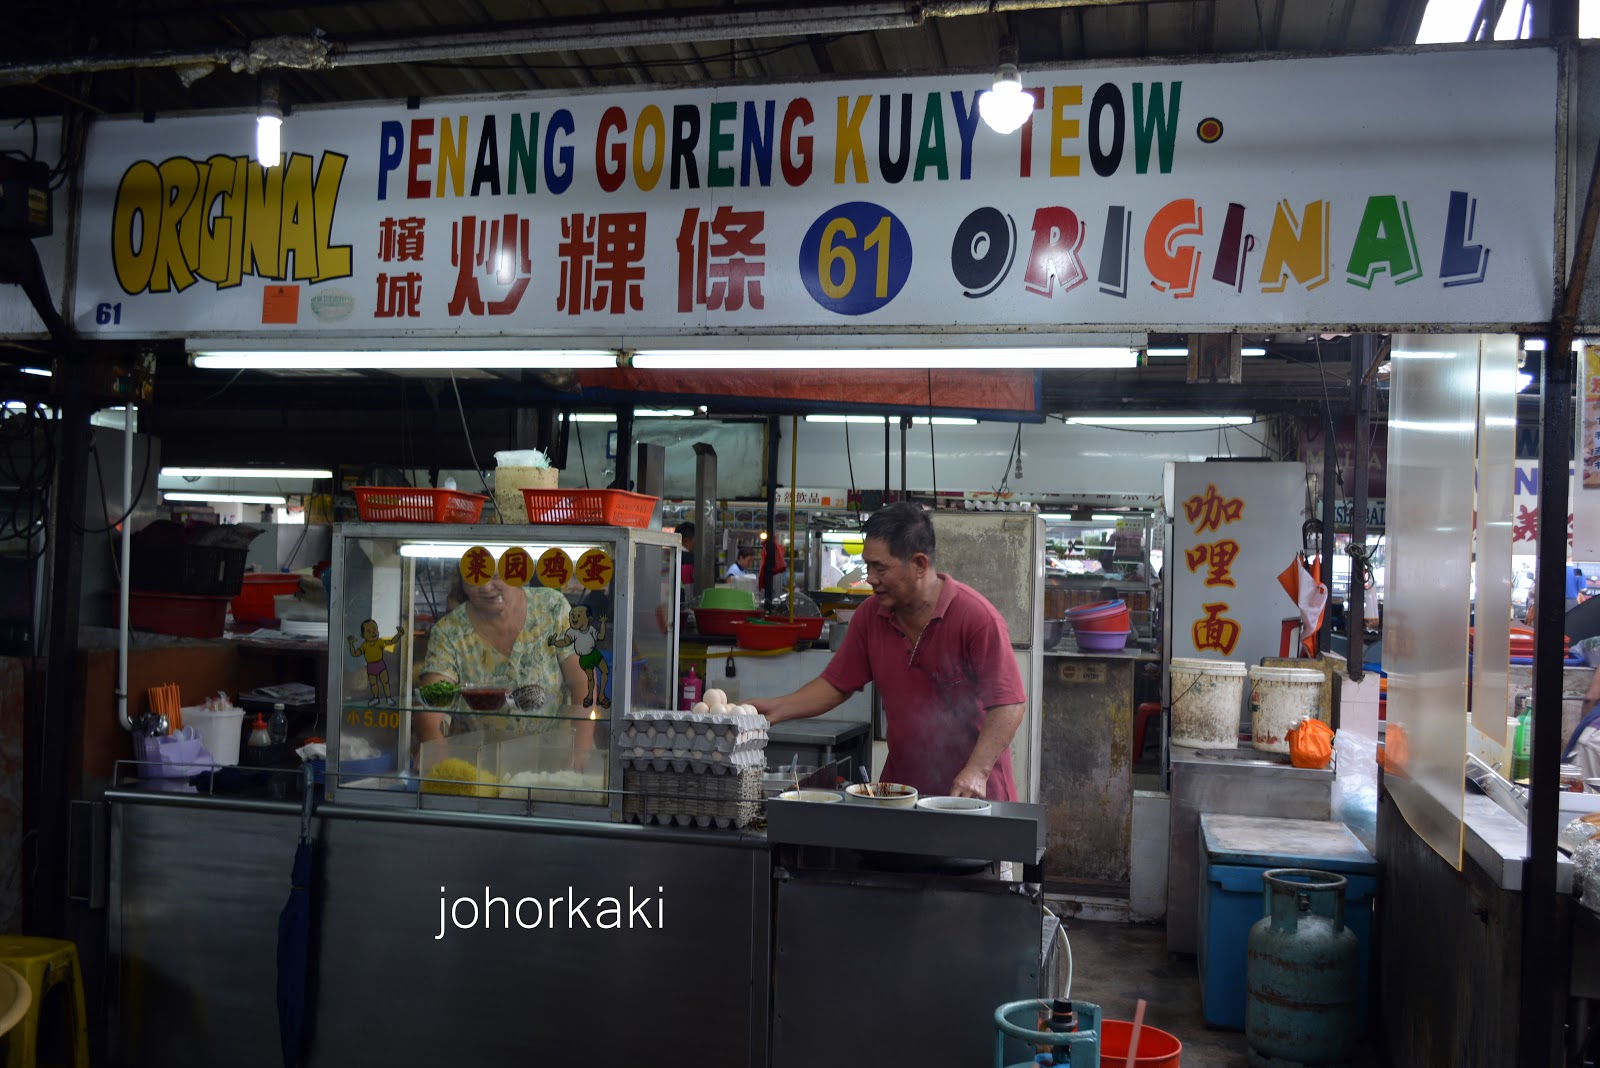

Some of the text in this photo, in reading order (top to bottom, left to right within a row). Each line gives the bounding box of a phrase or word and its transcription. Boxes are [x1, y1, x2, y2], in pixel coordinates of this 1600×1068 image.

[377, 81, 1183, 200] PENANG GORENG KUAY TEOW
[112, 150, 353, 296] ORIGINAL
[374, 205, 766, 318] 檳城 炒粿條
[818, 215, 891, 300] 61
[951, 190, 1490, 299] ORIGINAL
[95, 302, 122, 326] 61
[465, 549, 612, 586] 菜园鸡蛋
[1182, 484, 1246, 656] 咖哩面
[363, 709, 400, 729] 5.00
